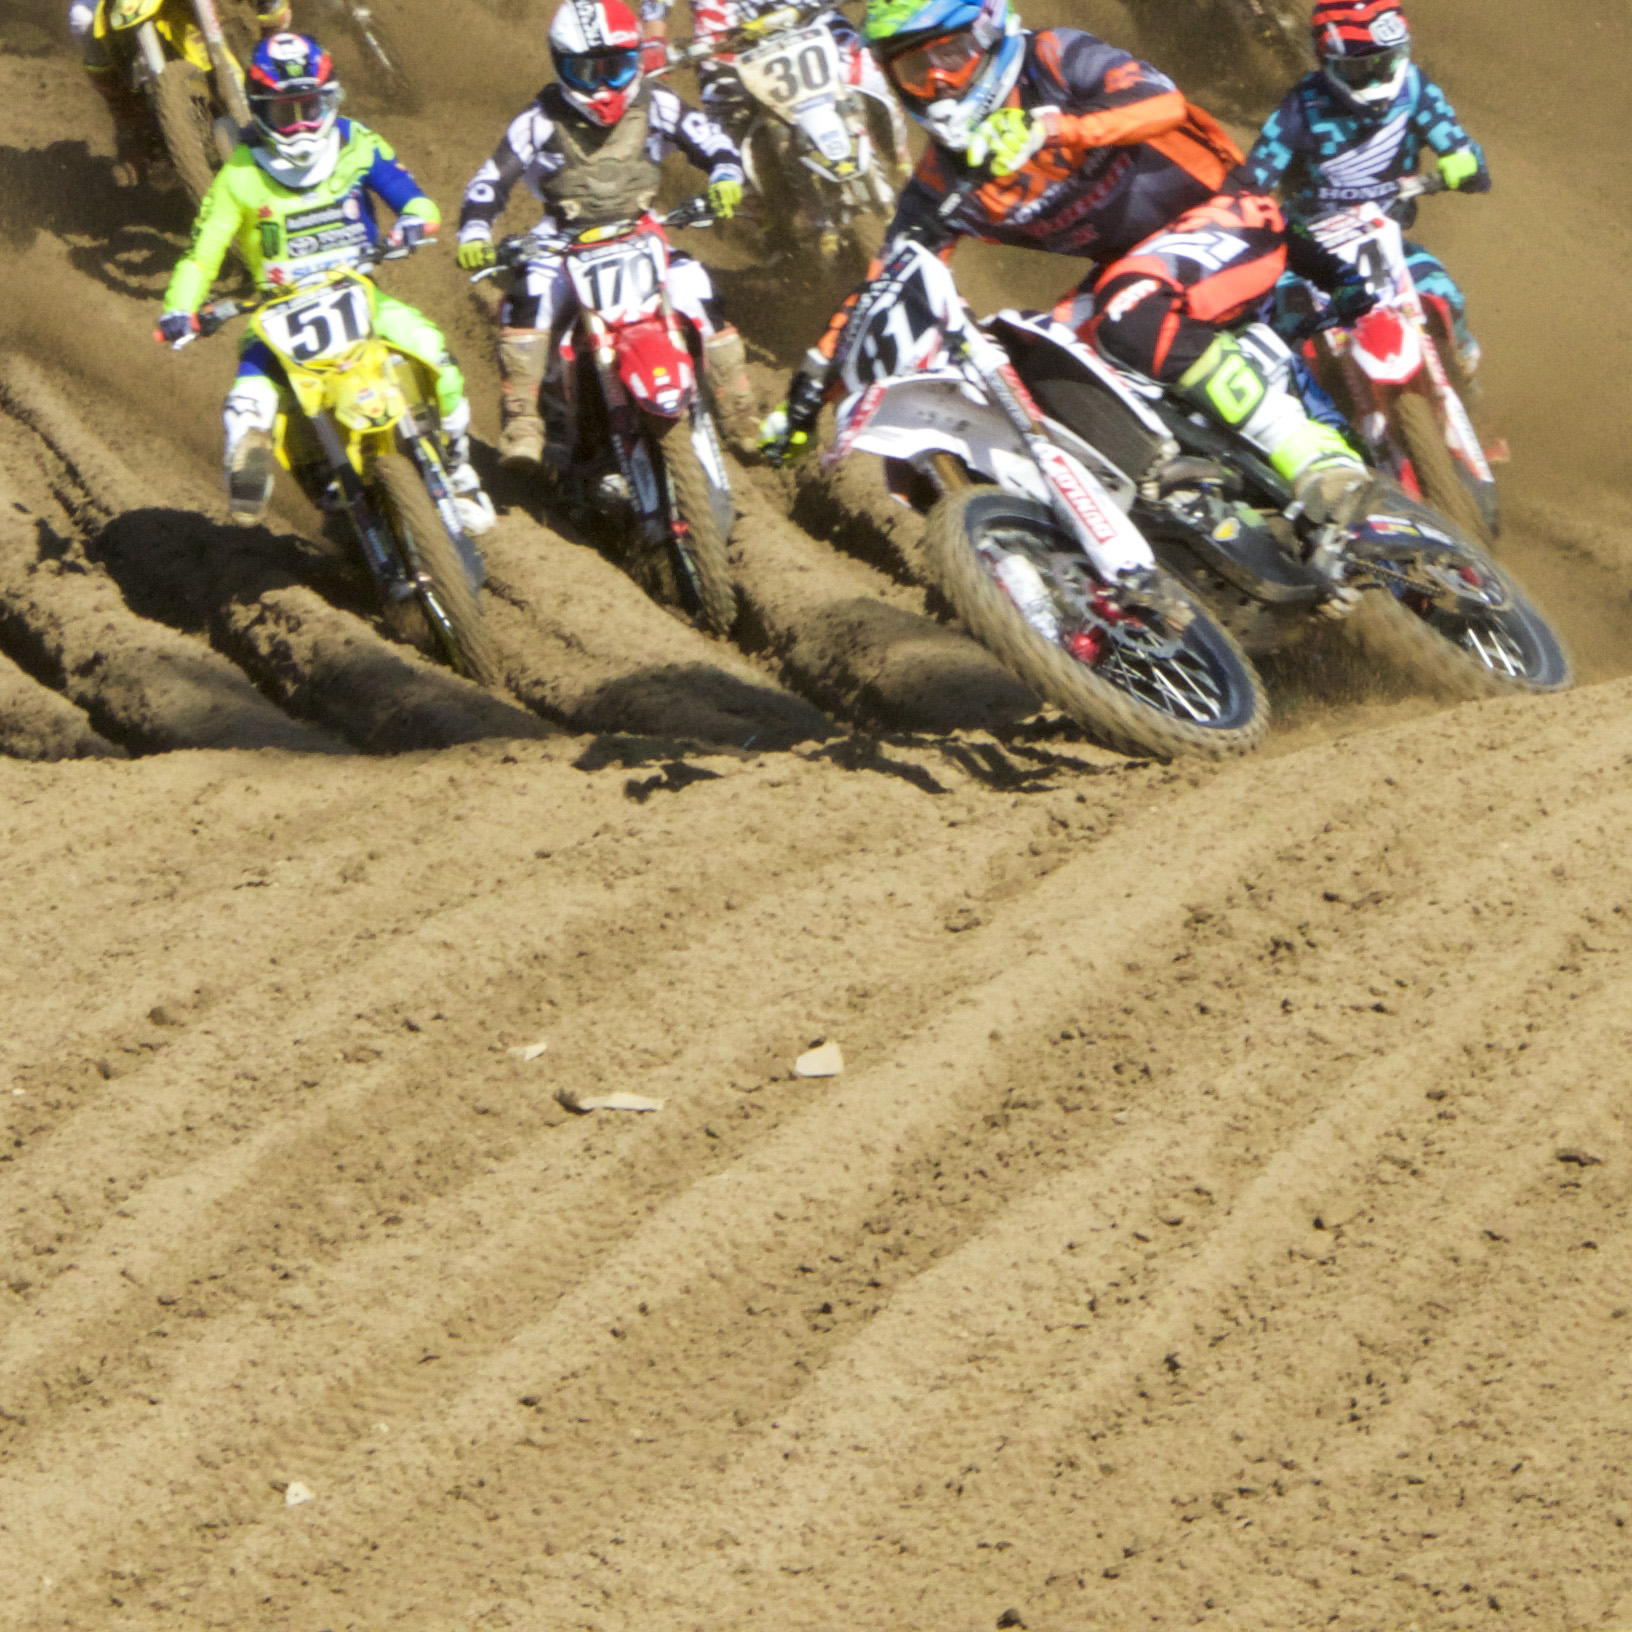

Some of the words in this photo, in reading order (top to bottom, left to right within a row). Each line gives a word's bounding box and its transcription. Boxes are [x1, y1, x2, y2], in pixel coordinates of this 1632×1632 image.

[768, 44, 831, 107] 30
[582, 247, 659, 319] 170
[285, 290, 361, 362] 51
